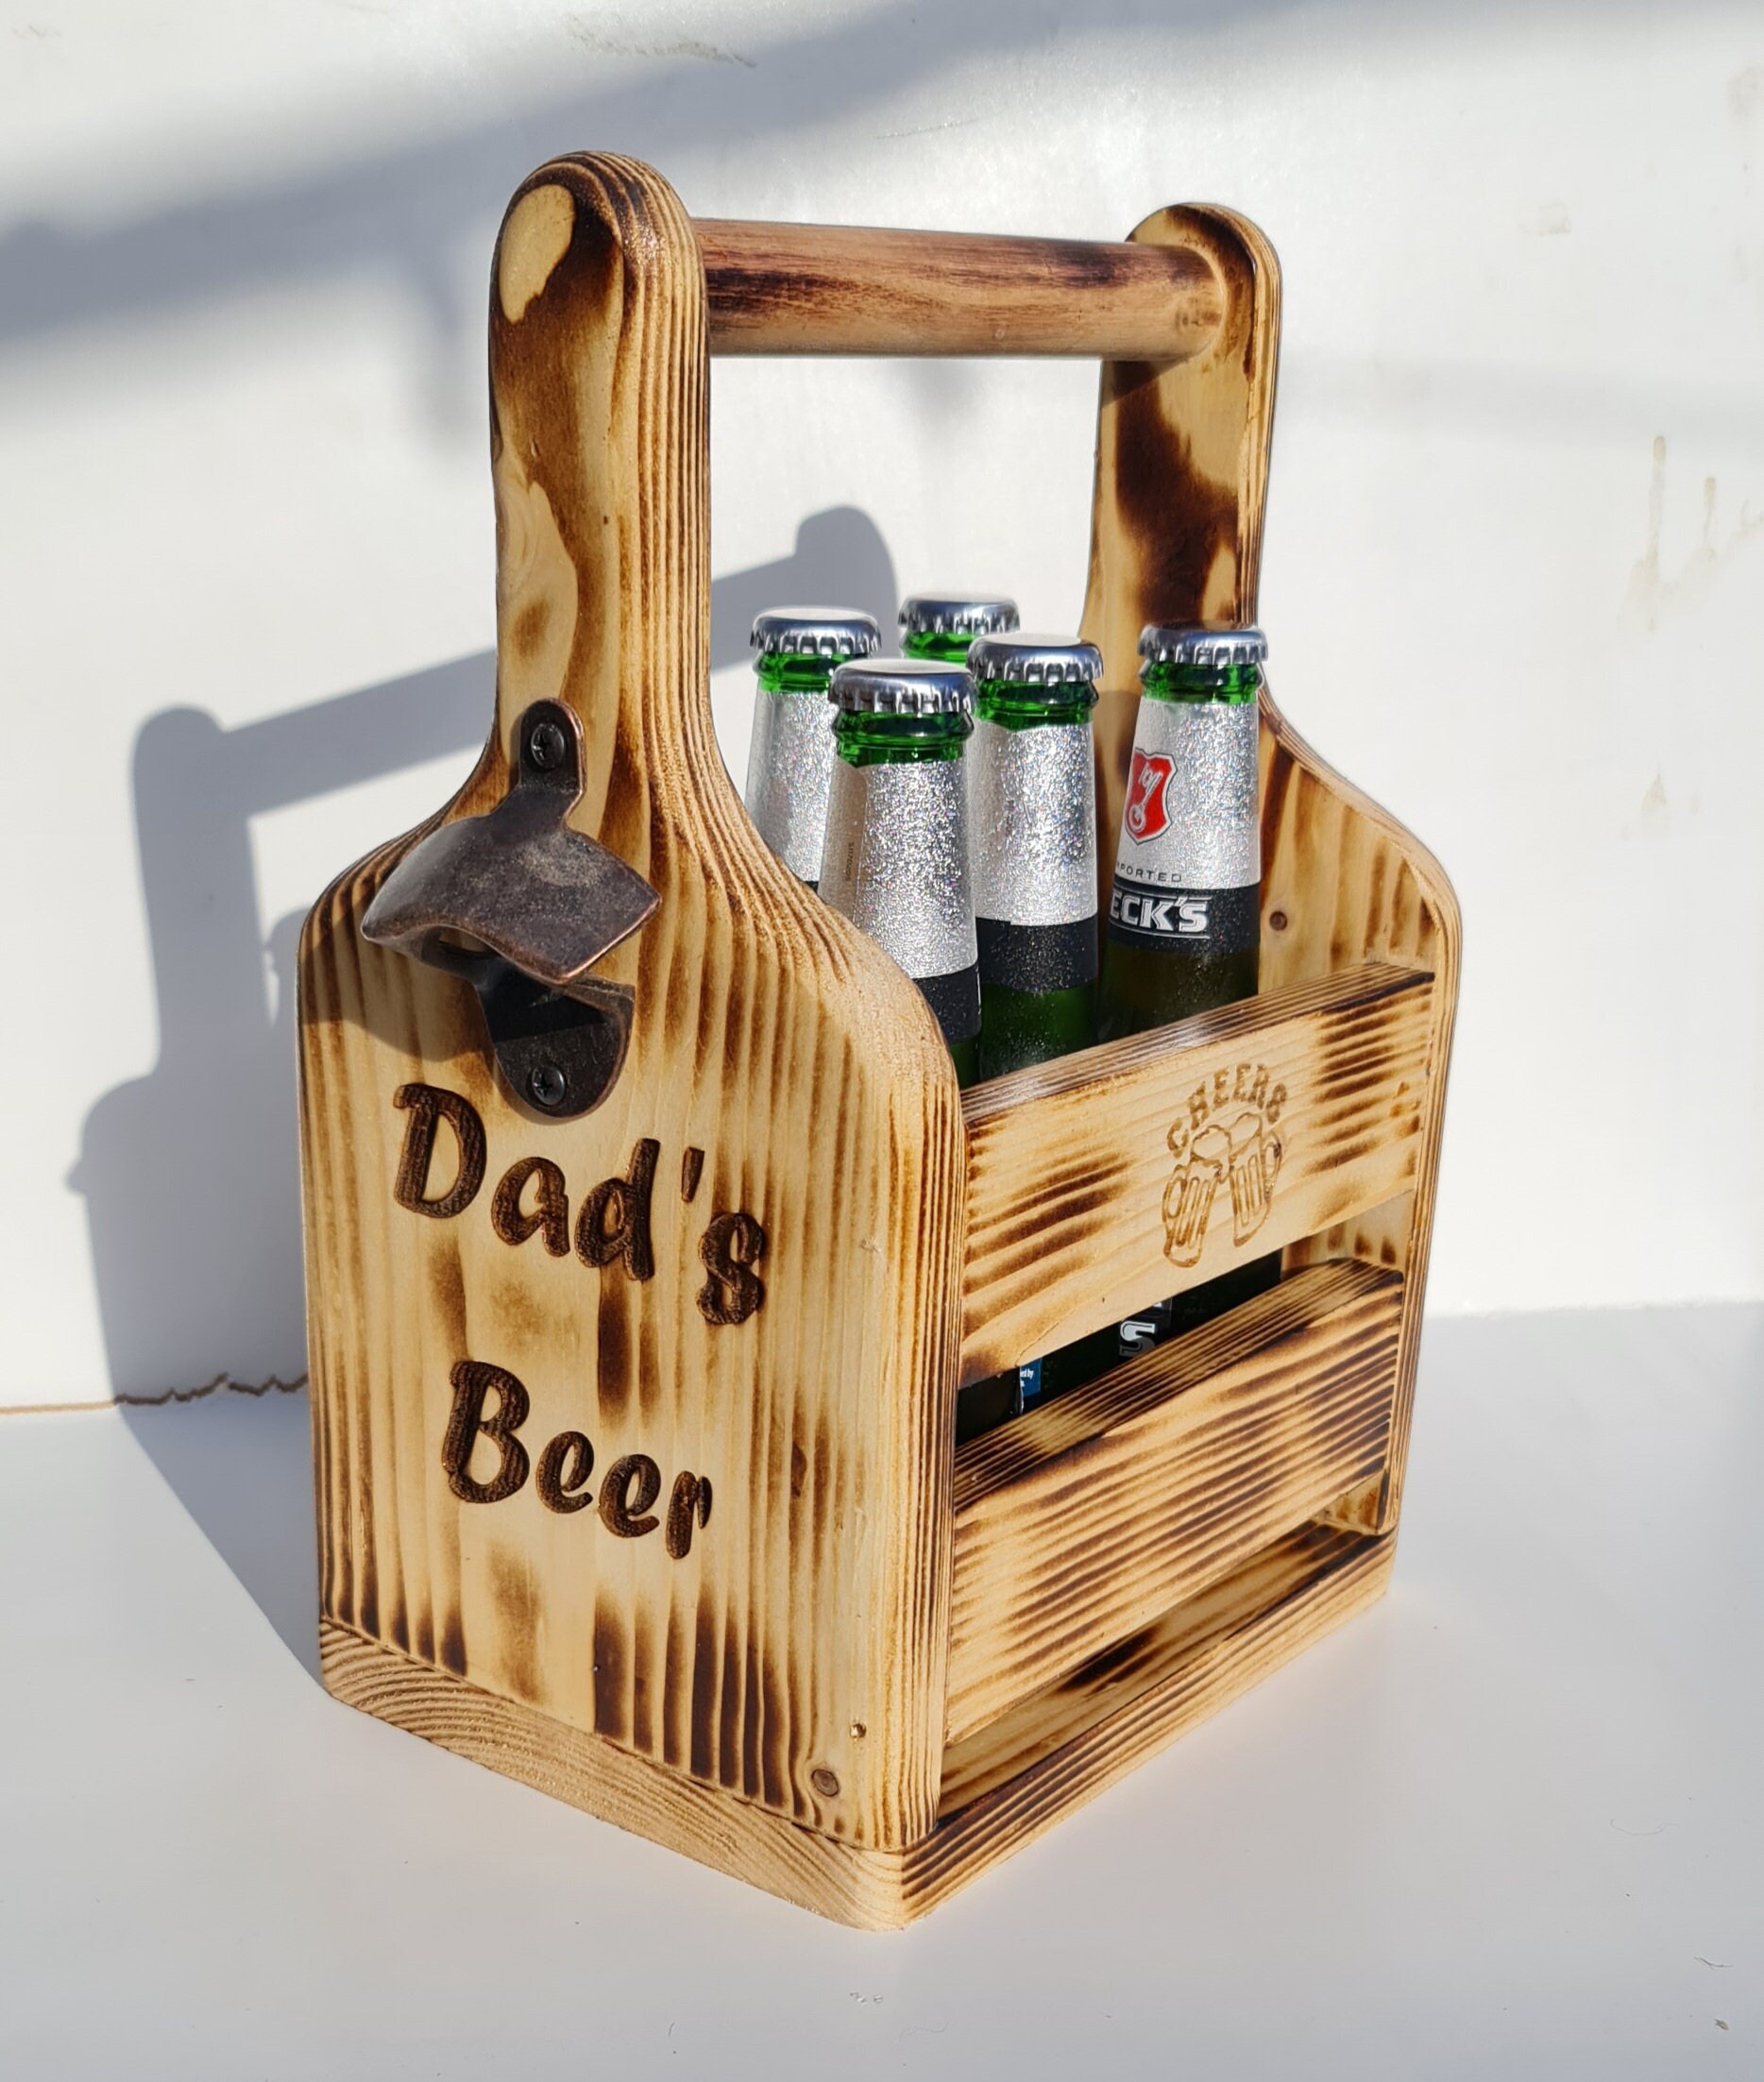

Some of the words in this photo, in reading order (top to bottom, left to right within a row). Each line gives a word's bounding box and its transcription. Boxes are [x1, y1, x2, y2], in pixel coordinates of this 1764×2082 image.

[393, 1083, 763, 1324] Dad's
[1167, 1063, 1287, 1158] CHEERS
[441, 1361, 712, 1559] Beer
